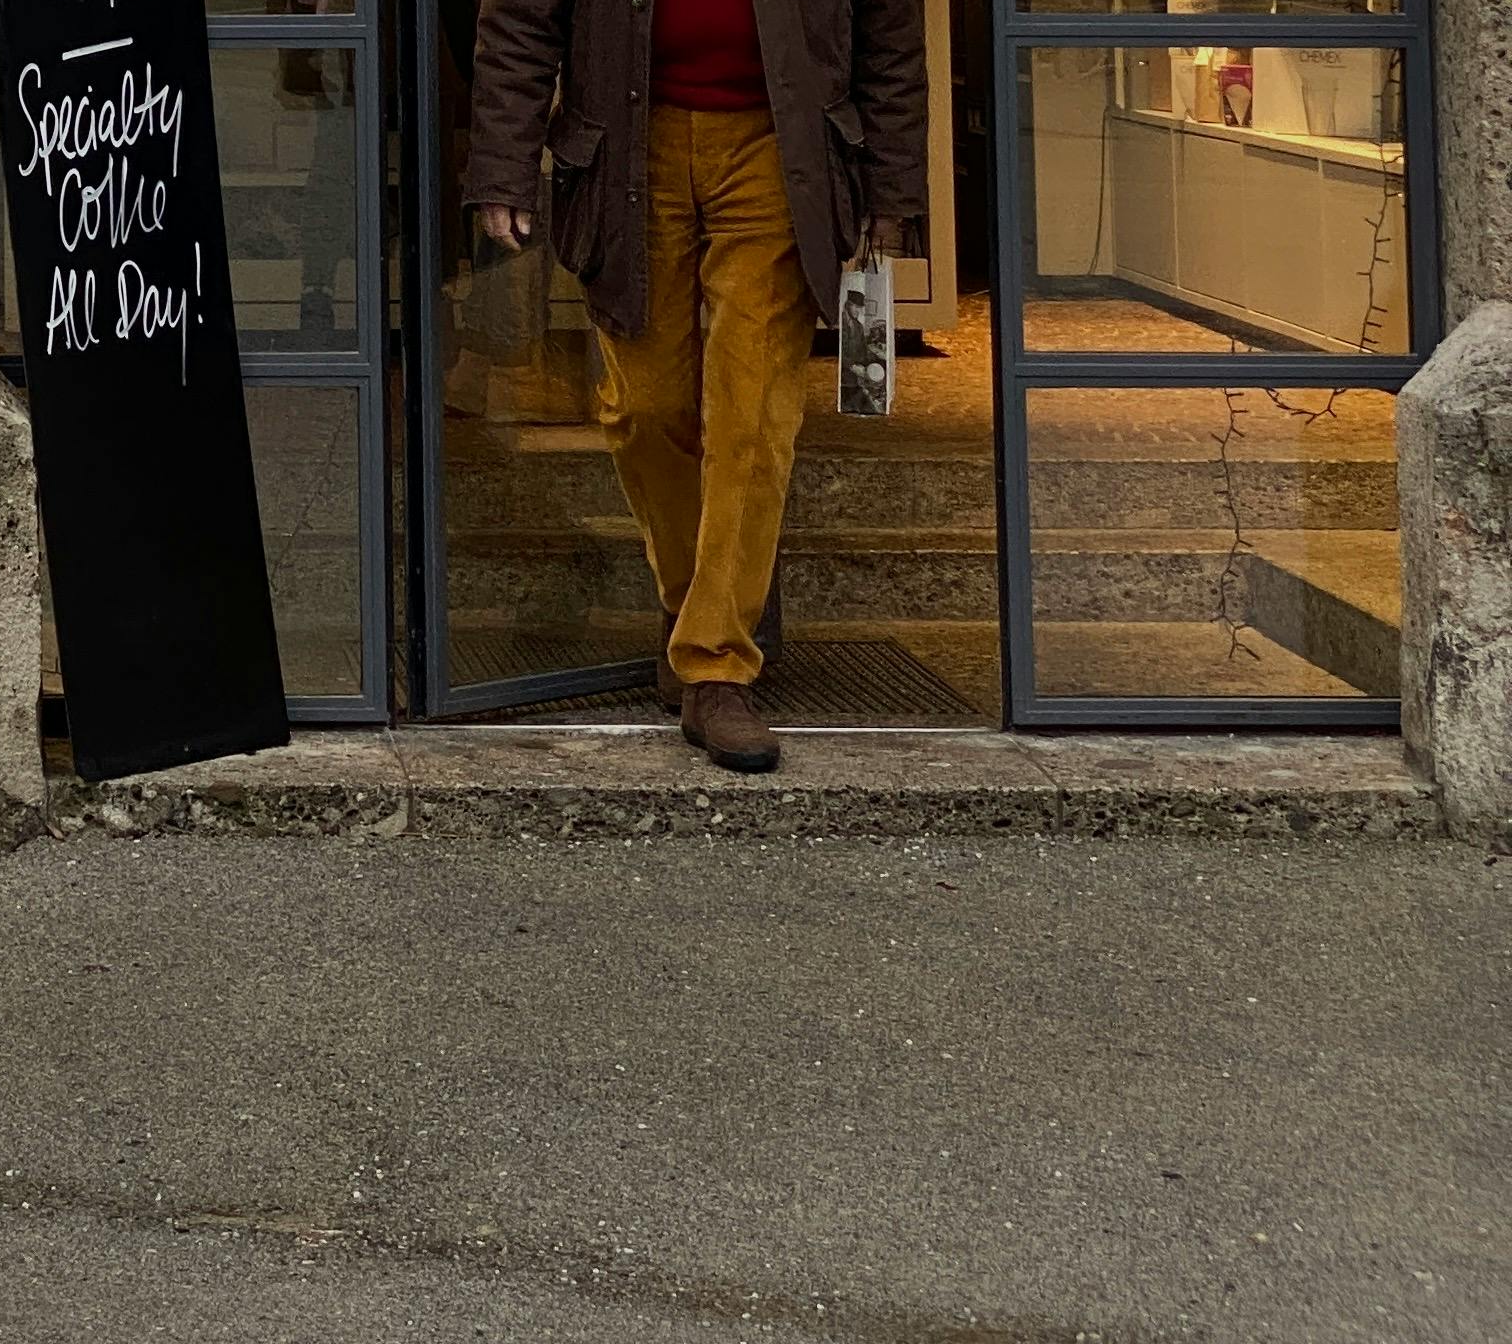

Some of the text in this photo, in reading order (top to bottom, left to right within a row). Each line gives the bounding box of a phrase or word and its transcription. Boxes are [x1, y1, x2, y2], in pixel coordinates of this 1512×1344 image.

[17, 62, 184, 197] Specialty
[45, 241, 204, 387] All Day!
